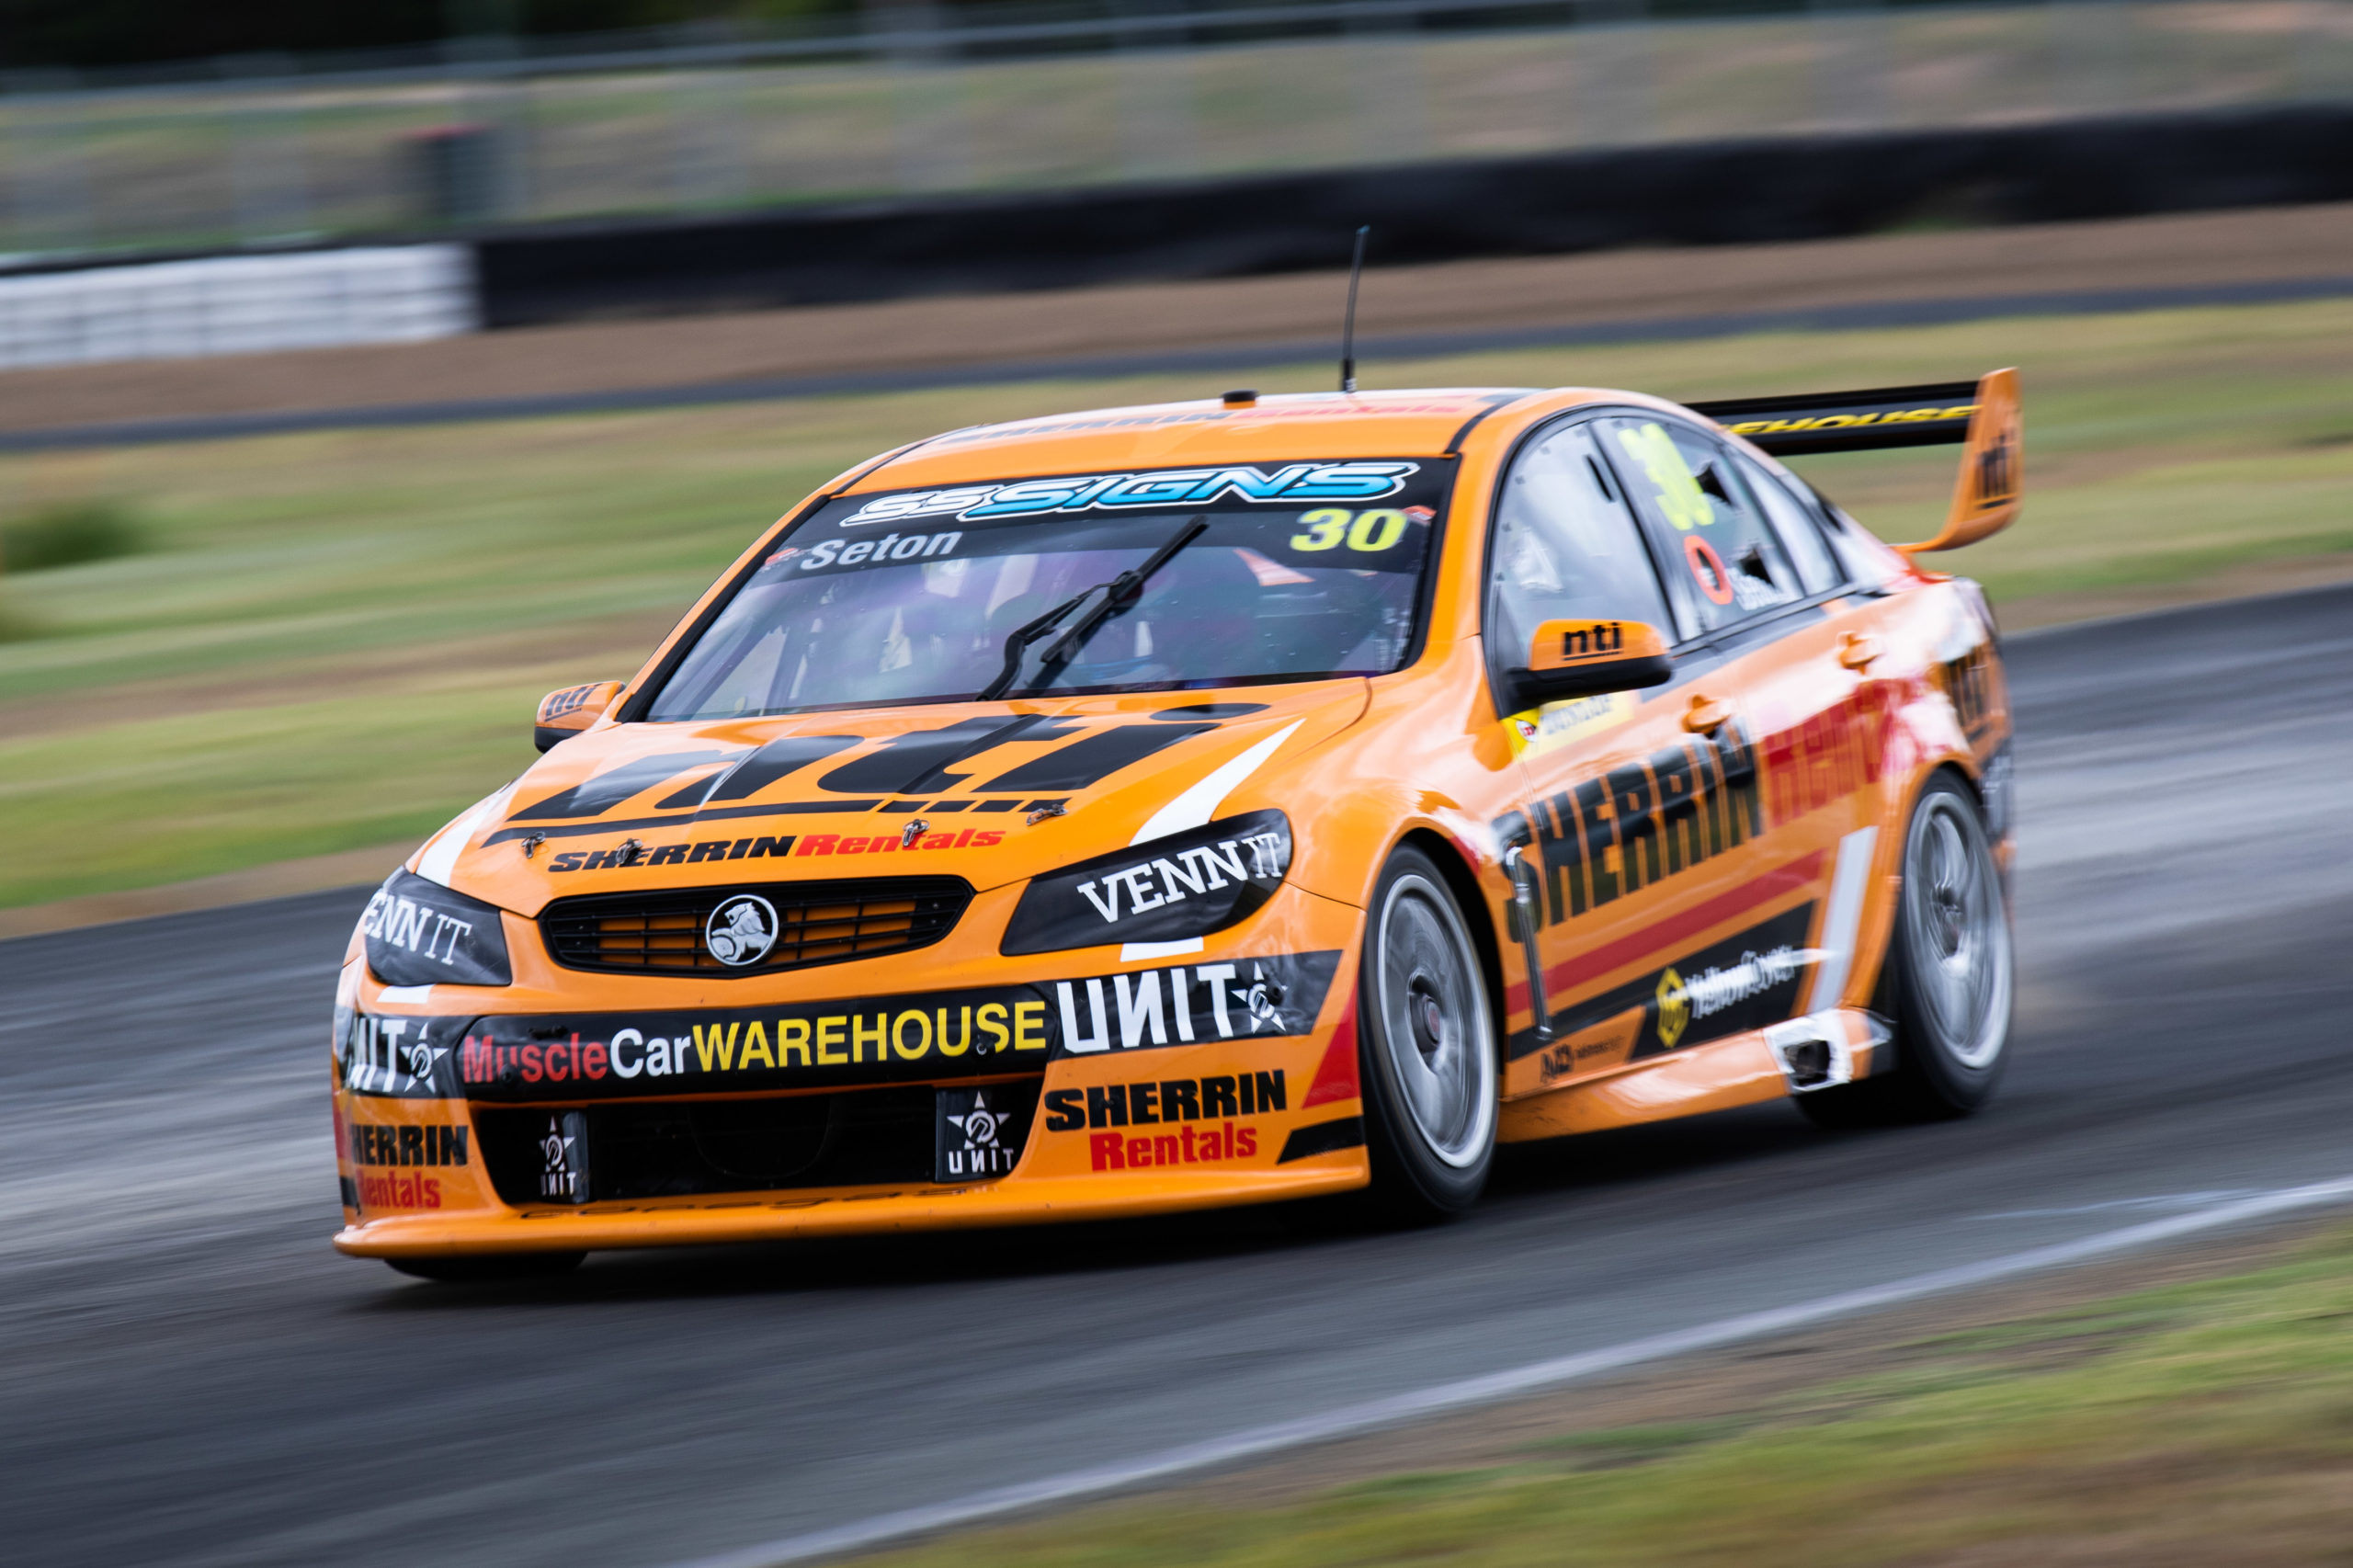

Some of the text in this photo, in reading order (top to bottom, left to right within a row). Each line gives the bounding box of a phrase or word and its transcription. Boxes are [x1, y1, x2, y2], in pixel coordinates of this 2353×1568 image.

[800, 530, 963, 571] Seton
[1290, 507, 1410, 552] 30
[1562, 621, 1623, 655] nti
[1076, 837, 1248, 923] VENN
[1045, 1068, 1286, 1132] SHERRIN
[1090, 1121, 1257, 1172] Rentals
